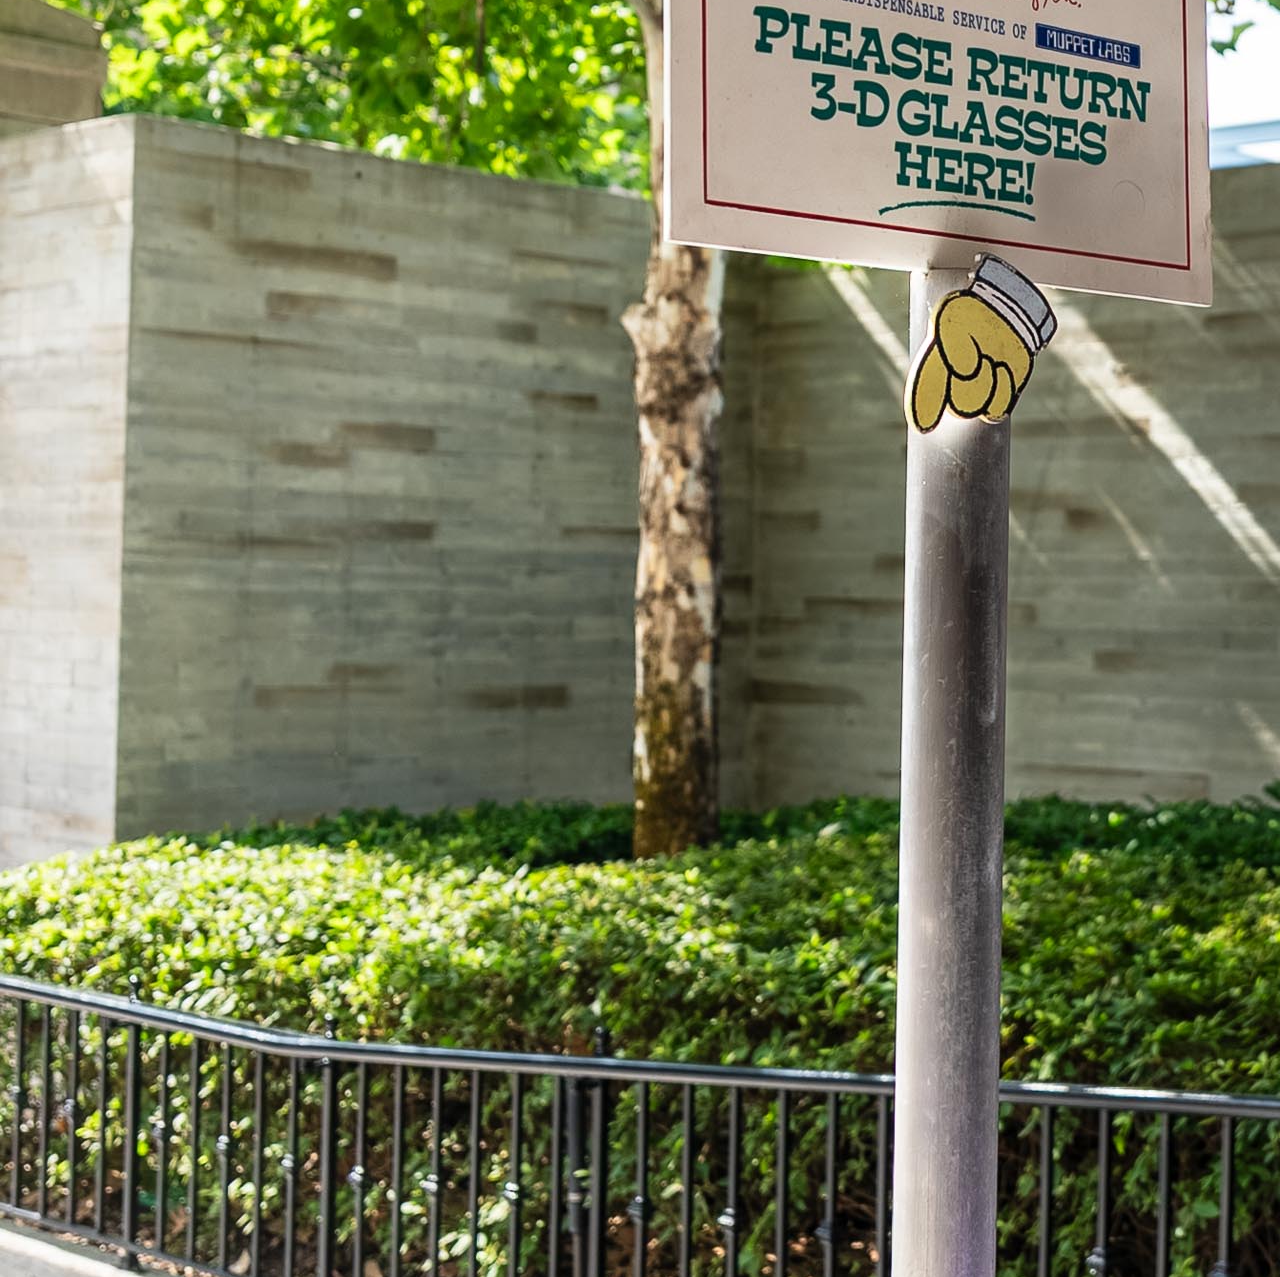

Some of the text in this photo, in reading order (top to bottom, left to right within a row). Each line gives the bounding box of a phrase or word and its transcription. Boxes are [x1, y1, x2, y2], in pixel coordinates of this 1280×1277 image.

[753, 5, 1151, 122] PLEASE RETURN
[952, 11, 1006, 35] SERVICE
[1012, 24, 1027, 40] OF
[1046, 29, 1096, 56] MUPPET
[1098, 40, 1131, 63] LABS
[810, 72, 1107, 166] 3-D GLASSES
[894, 141, 1036, 206] HERE!
